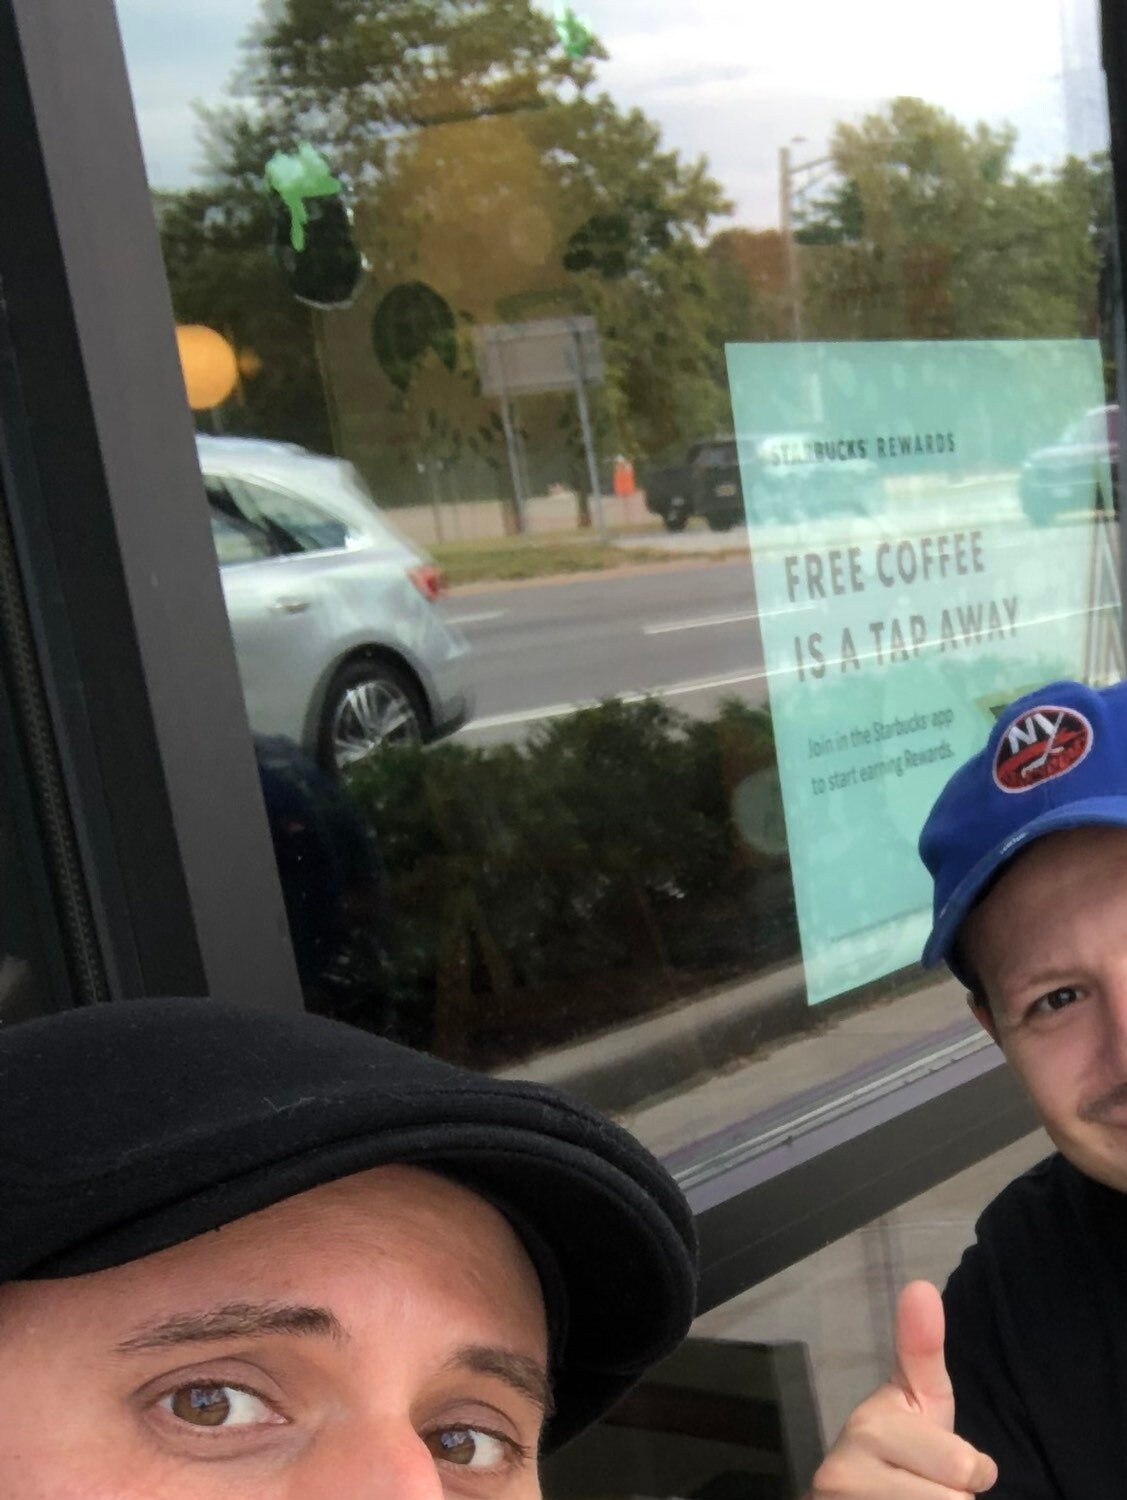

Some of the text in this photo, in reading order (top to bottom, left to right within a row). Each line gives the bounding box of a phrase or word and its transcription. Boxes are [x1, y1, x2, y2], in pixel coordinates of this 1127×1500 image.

[877, 433, 956, 458] REWARDS
[785, 531, 985, 602] FREE COFFEE
[794, 597, 1019, 682] IS A TAP AWAY
[808, 737, 834, 759] Join
[836, 734, 849, 751] in
[850, 725, 872, 747] the
[931, 709, 954, 730] app
[811, 777, 826, 795] to
[828, 768, 858, 791] start
[860, 757, 904, 777] earning
